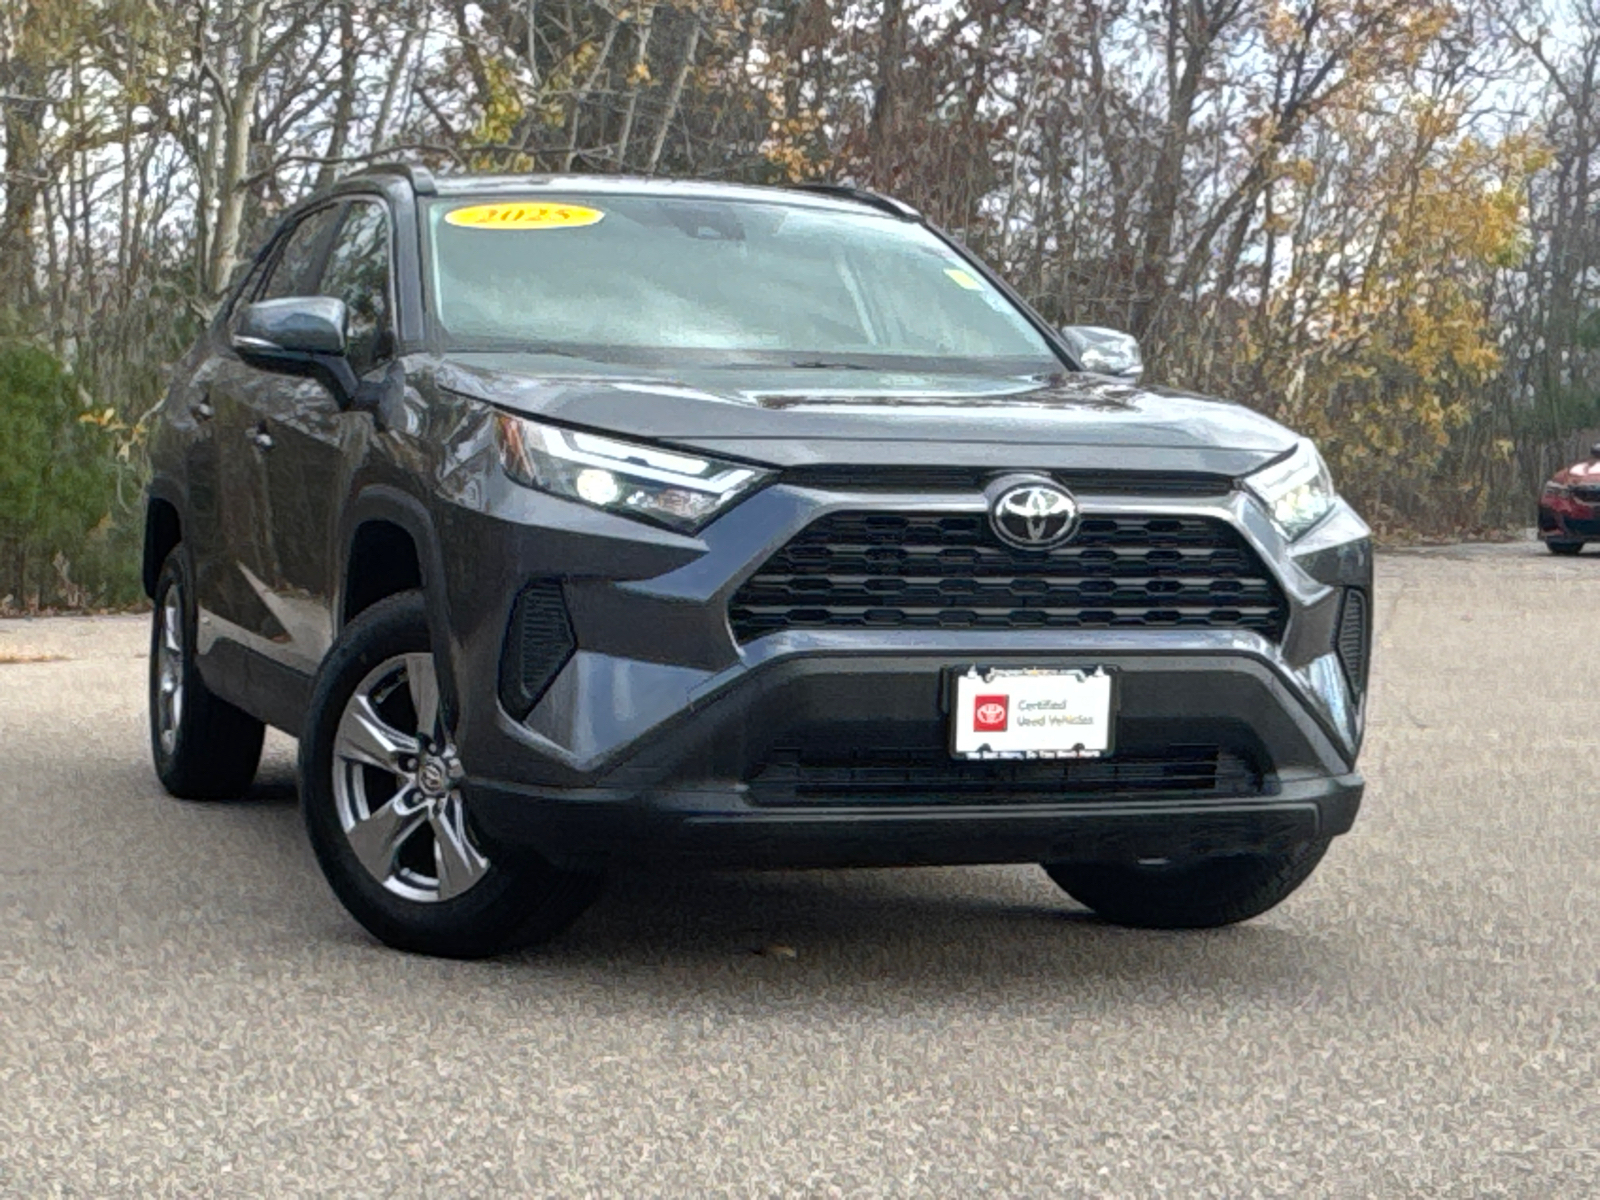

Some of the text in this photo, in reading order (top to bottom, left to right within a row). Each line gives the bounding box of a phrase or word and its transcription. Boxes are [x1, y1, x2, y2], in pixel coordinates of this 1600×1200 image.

[474, 208, 571, 223] 2025
[1018, 700, 1067, 711] Certified
[1017, 716, 1094, 727] Used Vehicles
